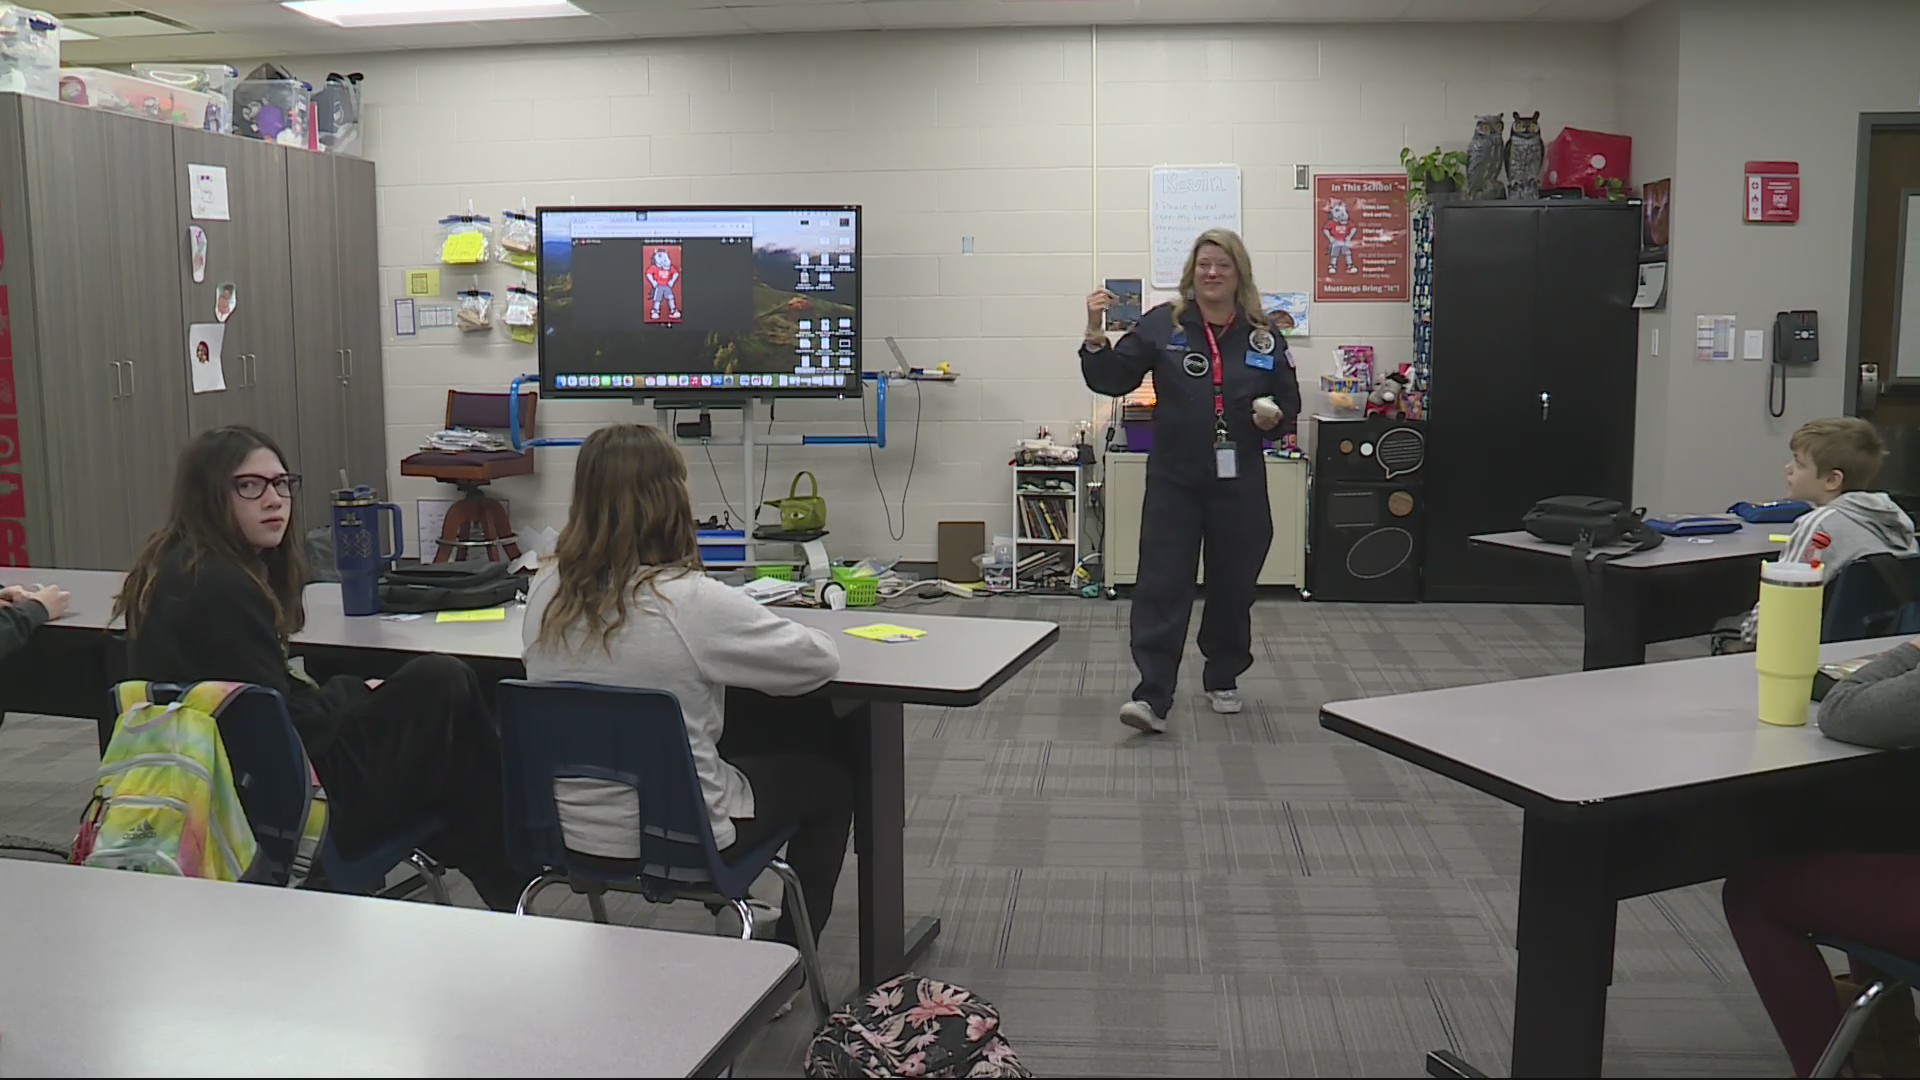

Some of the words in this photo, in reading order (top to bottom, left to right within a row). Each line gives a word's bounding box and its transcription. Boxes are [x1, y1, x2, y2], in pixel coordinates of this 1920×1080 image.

[1162, 171, 1227, 194] Kevin
[1331, 183, 1341, 191] In
[1343, 183, 1360, 191] This
[1362, 182, 1392, 191] School
[1324, 285, 1360, 293] Mustangs
[1362, 284, 1382, 293] Bring
[122, 831, 156, 840] adidas
